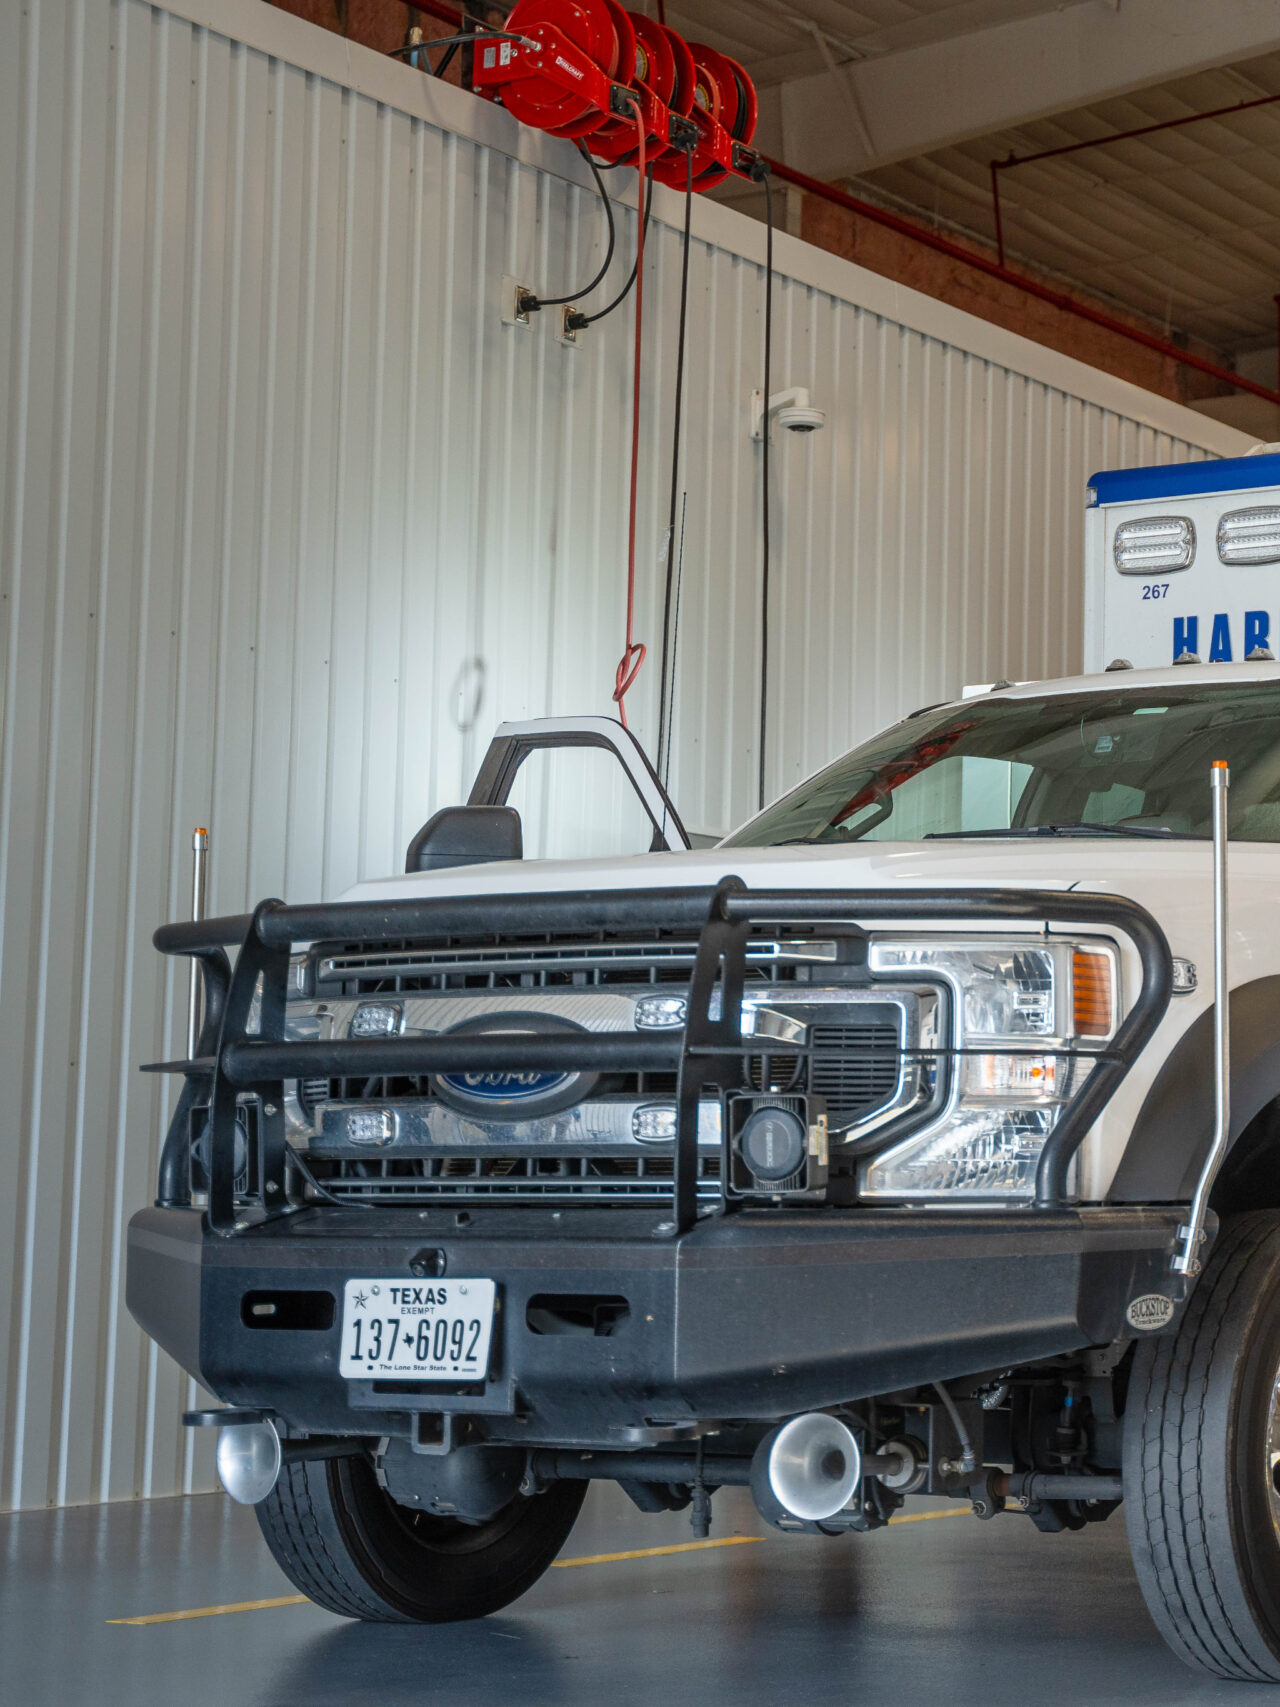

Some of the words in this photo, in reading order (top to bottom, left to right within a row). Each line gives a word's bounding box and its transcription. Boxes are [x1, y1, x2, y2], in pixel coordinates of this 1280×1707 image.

[1142, 584, 1170, 600] 267
[390, 1288, 447, 1305] TEXAS
[400, 1307, 435, 1315] EXEMPT
